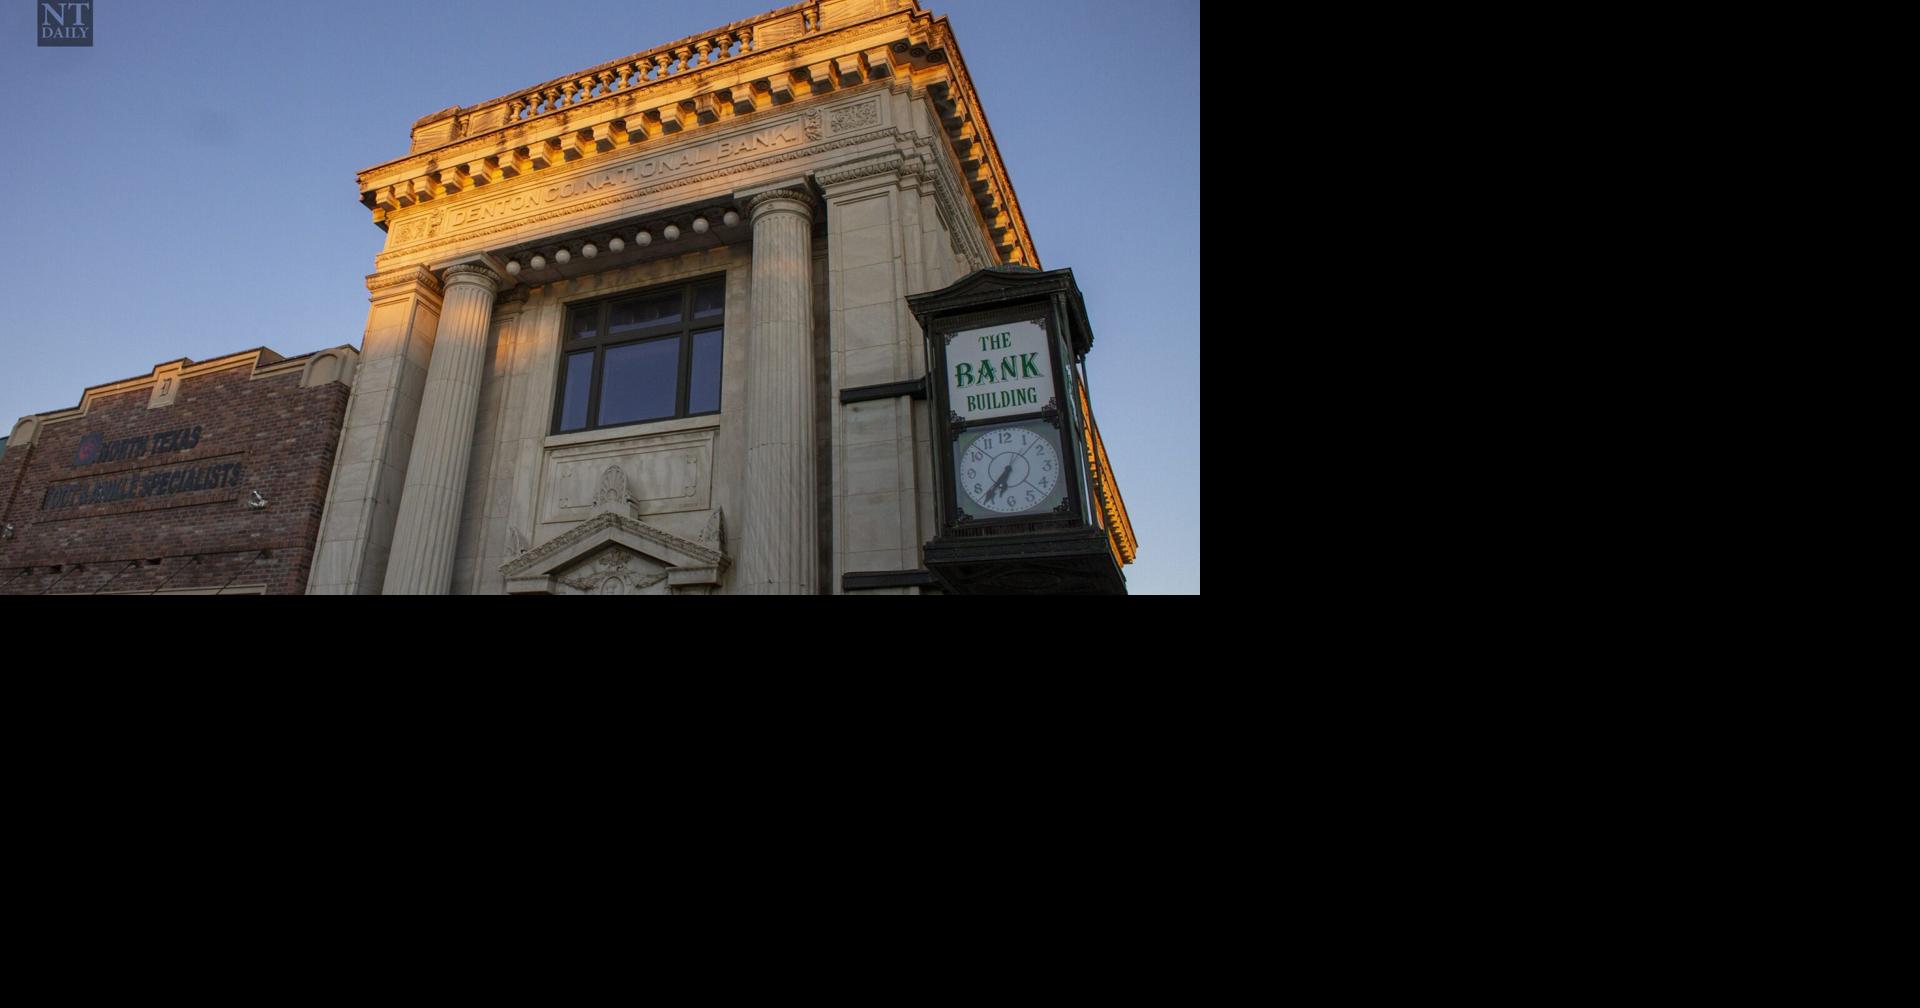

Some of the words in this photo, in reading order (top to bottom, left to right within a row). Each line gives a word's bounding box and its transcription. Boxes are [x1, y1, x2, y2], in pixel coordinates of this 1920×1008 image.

[451, 193, 542, 227] DENTON
[580, 150, 711, 194] NATIONAL
[717, 125, 797, 160] BANK
[979, 331, 1012, 352] THE
[954, 351, 1045, 388] BANK
[967, 387, 1037, 412] BUILDING
[98, 435, 150, 463] NORTH
[151, 425, 202, 454] TEXAS
[984, 438, 992, 450] 11
[998, 432, 1012, 444] 12
[1021, 434, 1027, 446] 1
[971, 450, 983, 462] 10
[1035, 444, 1045, 457] 2
[1042, 459, 1051, 472] 3
[140, 463, 241, 497] SPECIALISTS
[1038, 476, 1049, 489] 4
[974, 482, 983, 494] 8
[1006, 495, 1017, 507] 6
[1025, 488, 1036, 503] 5
